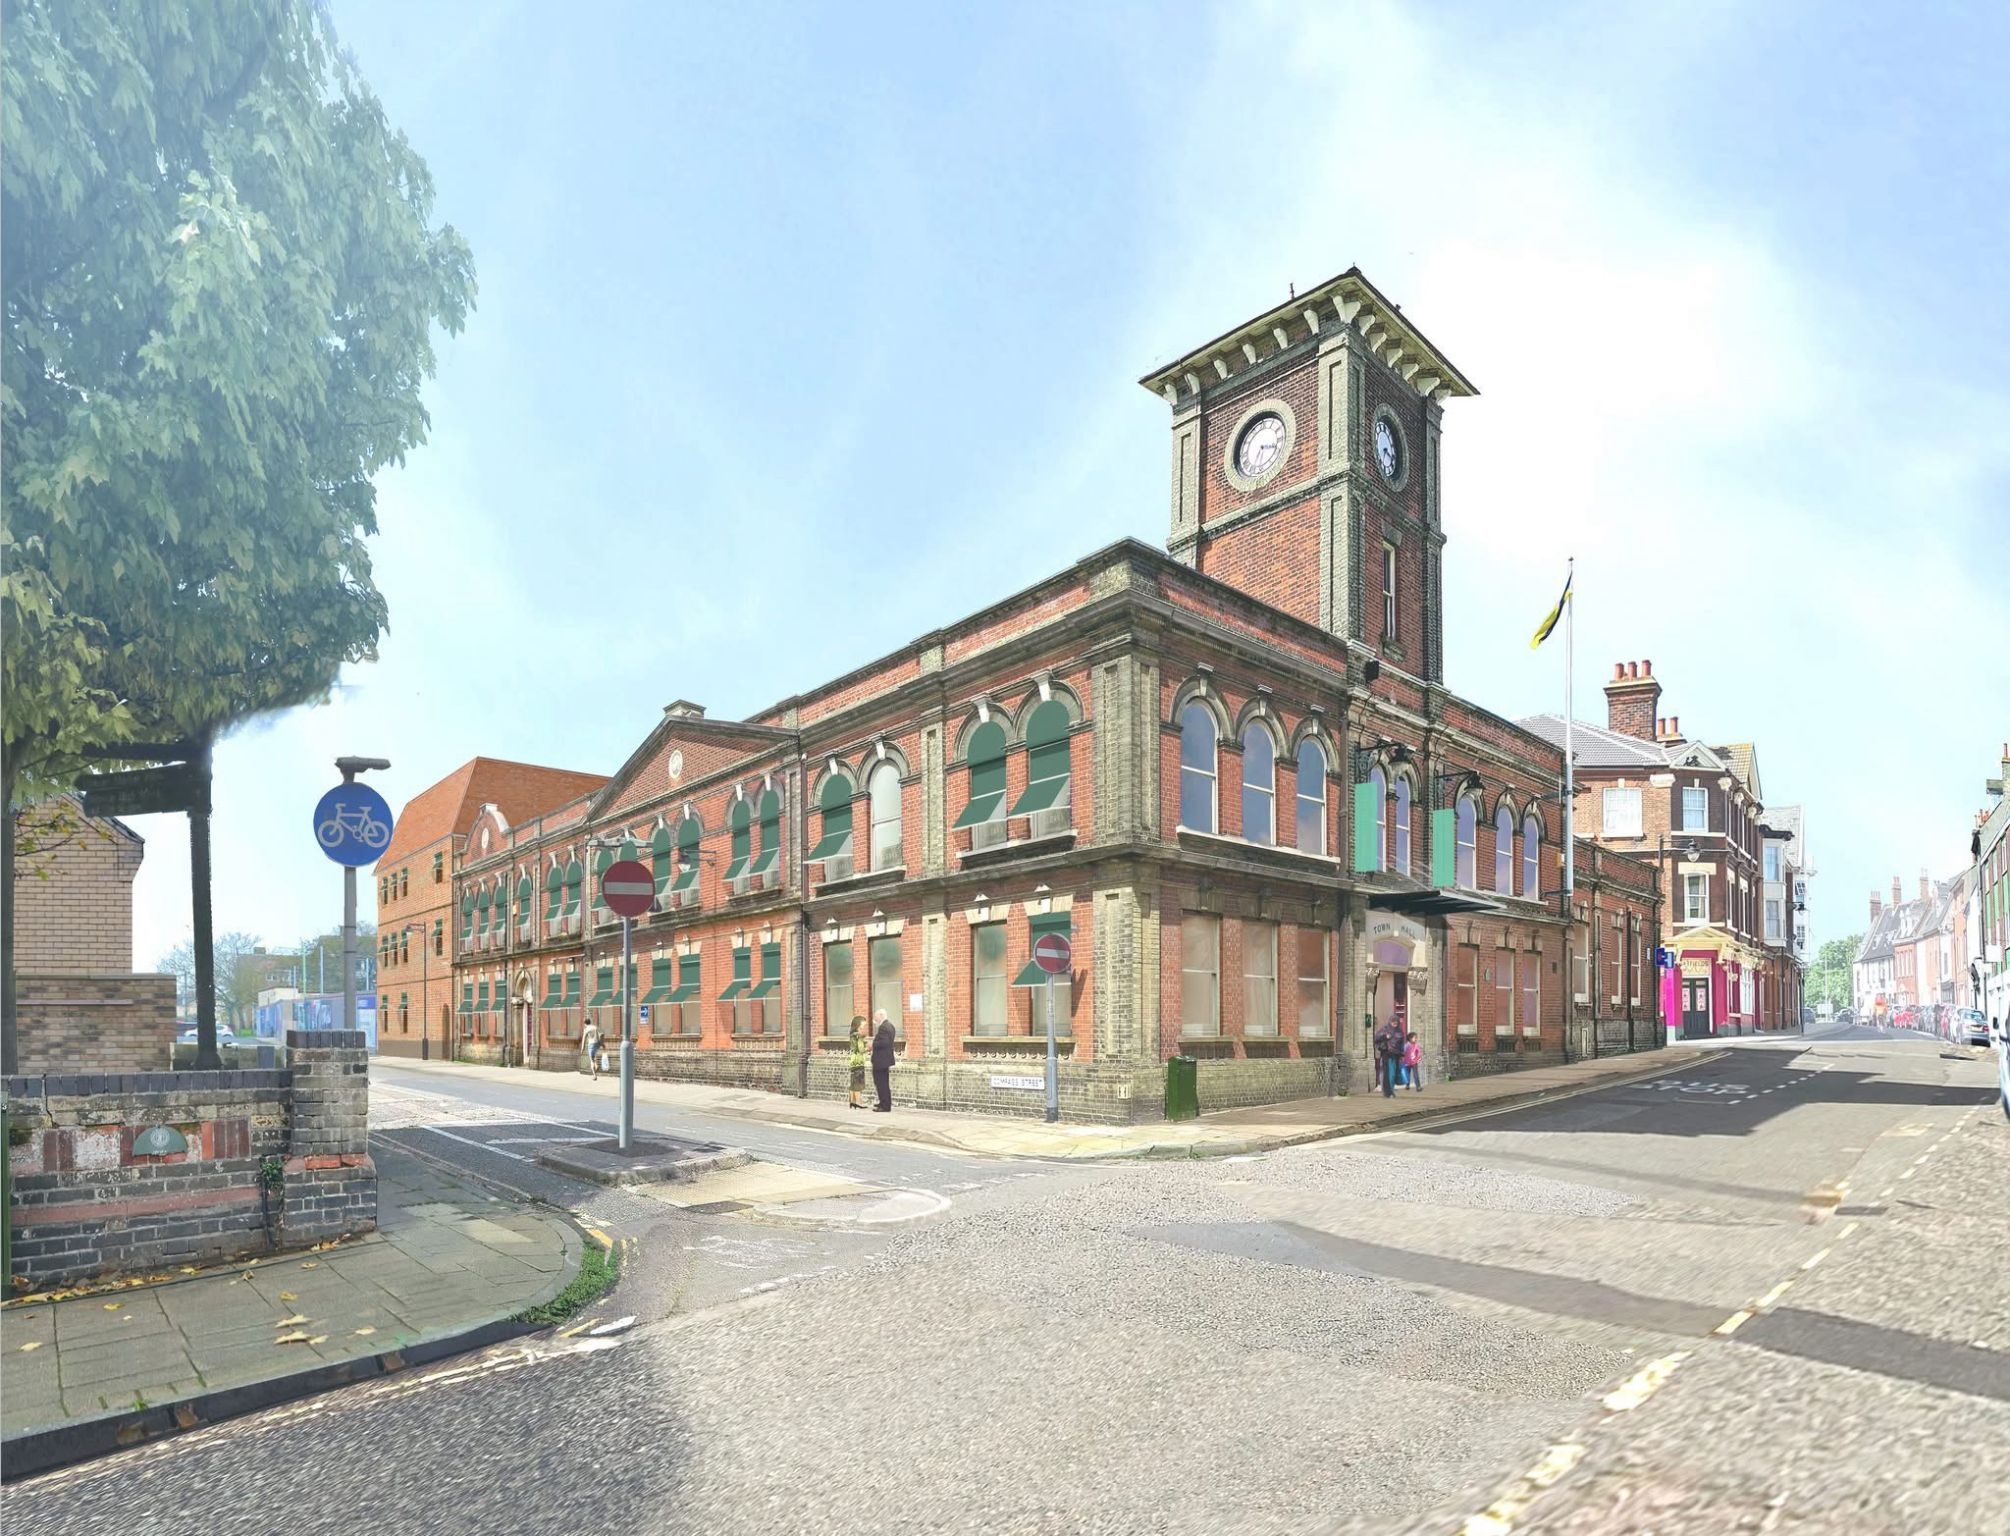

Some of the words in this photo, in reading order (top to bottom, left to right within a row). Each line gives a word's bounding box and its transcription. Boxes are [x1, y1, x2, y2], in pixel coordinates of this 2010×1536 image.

[1373, 923, 1391, 935] TOWN
[1400, 925, 1416, 940] HALL
[993, 1077, 1019, 1087] COMPASS
[1021, 1078, 1043, 1087] STREET
